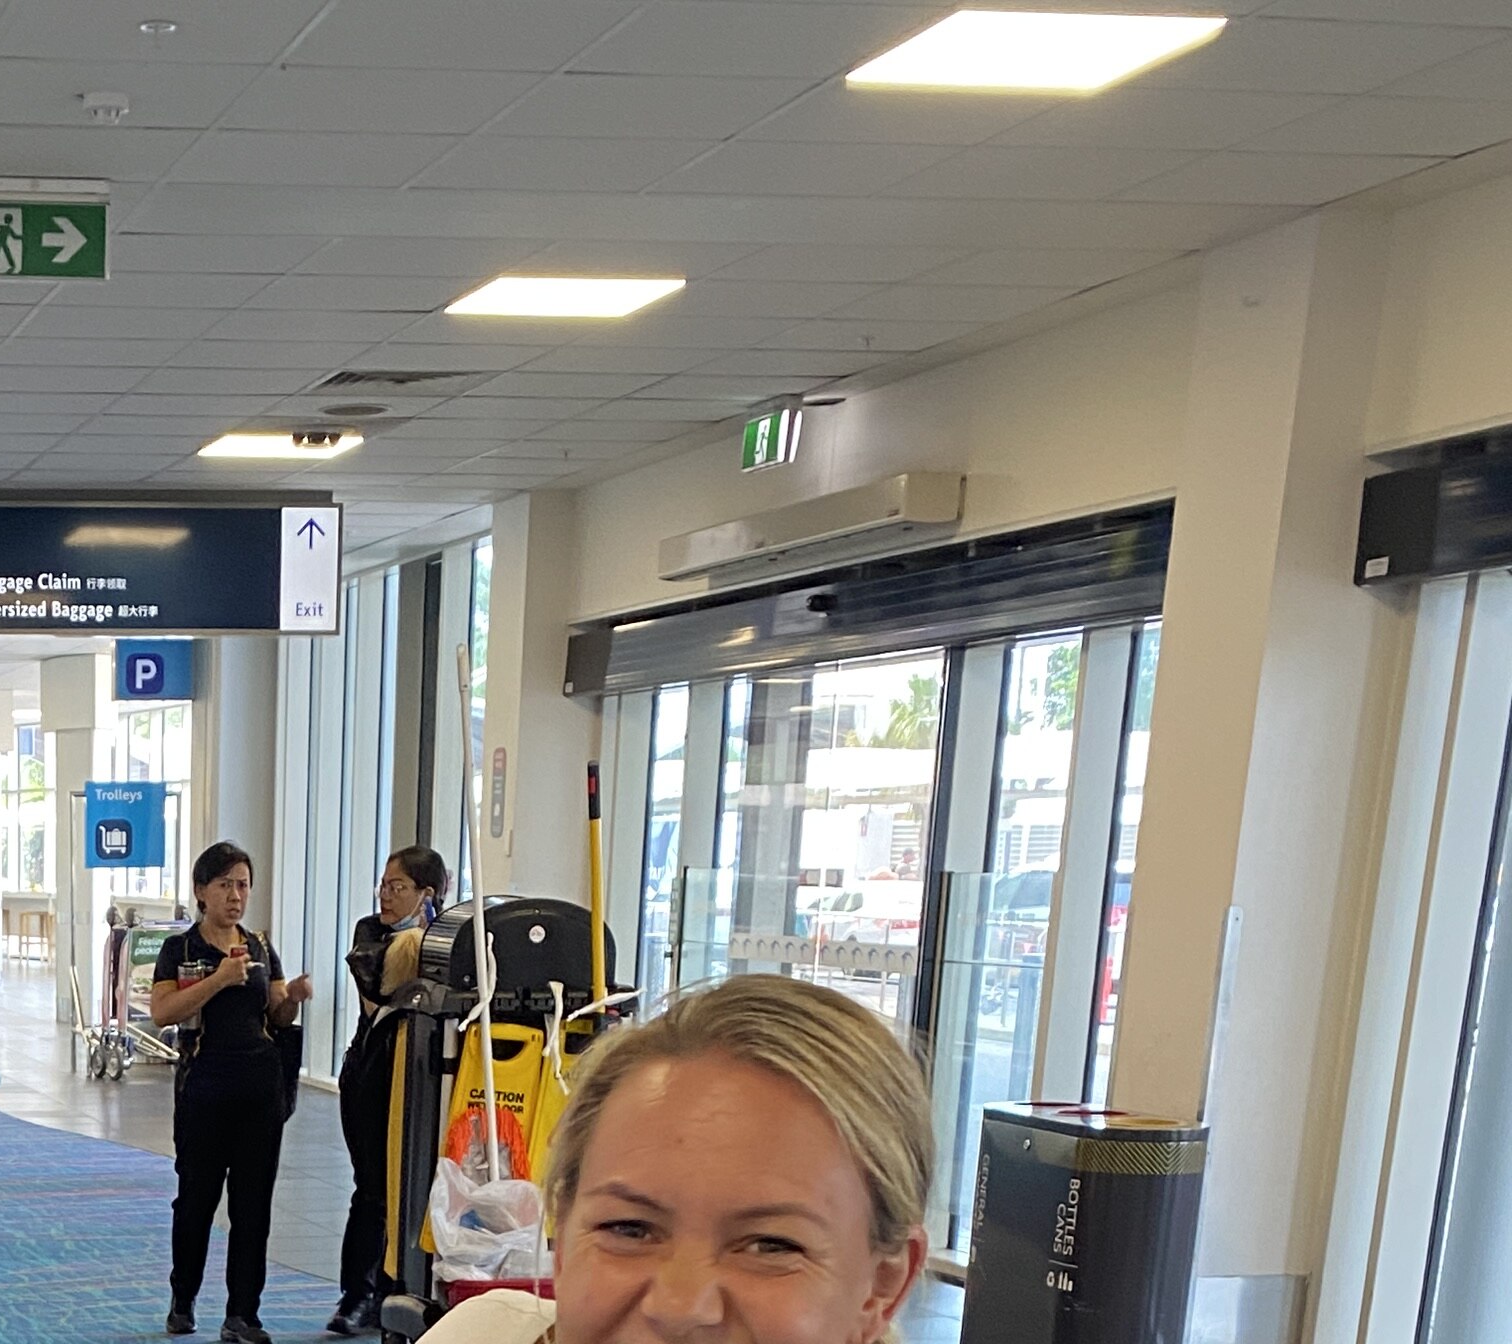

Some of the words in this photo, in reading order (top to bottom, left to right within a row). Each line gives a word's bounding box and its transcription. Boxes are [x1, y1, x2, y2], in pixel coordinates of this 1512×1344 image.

[38, 573, 81, 590] Claim
[51, 601, 114, 622] Baggage
[296, 601, 323, 616] Exit
[135, 658, 157, 689] P
[95, 788, 143, 804] Trolleys
[469, 1089, 525, 1103] CATION
[974, 1153, 990, 1230] GENERAL
[1063, 1178, 1081, 1256] BOTTLES
[1053, 1203, 1066, 1253] CANS
